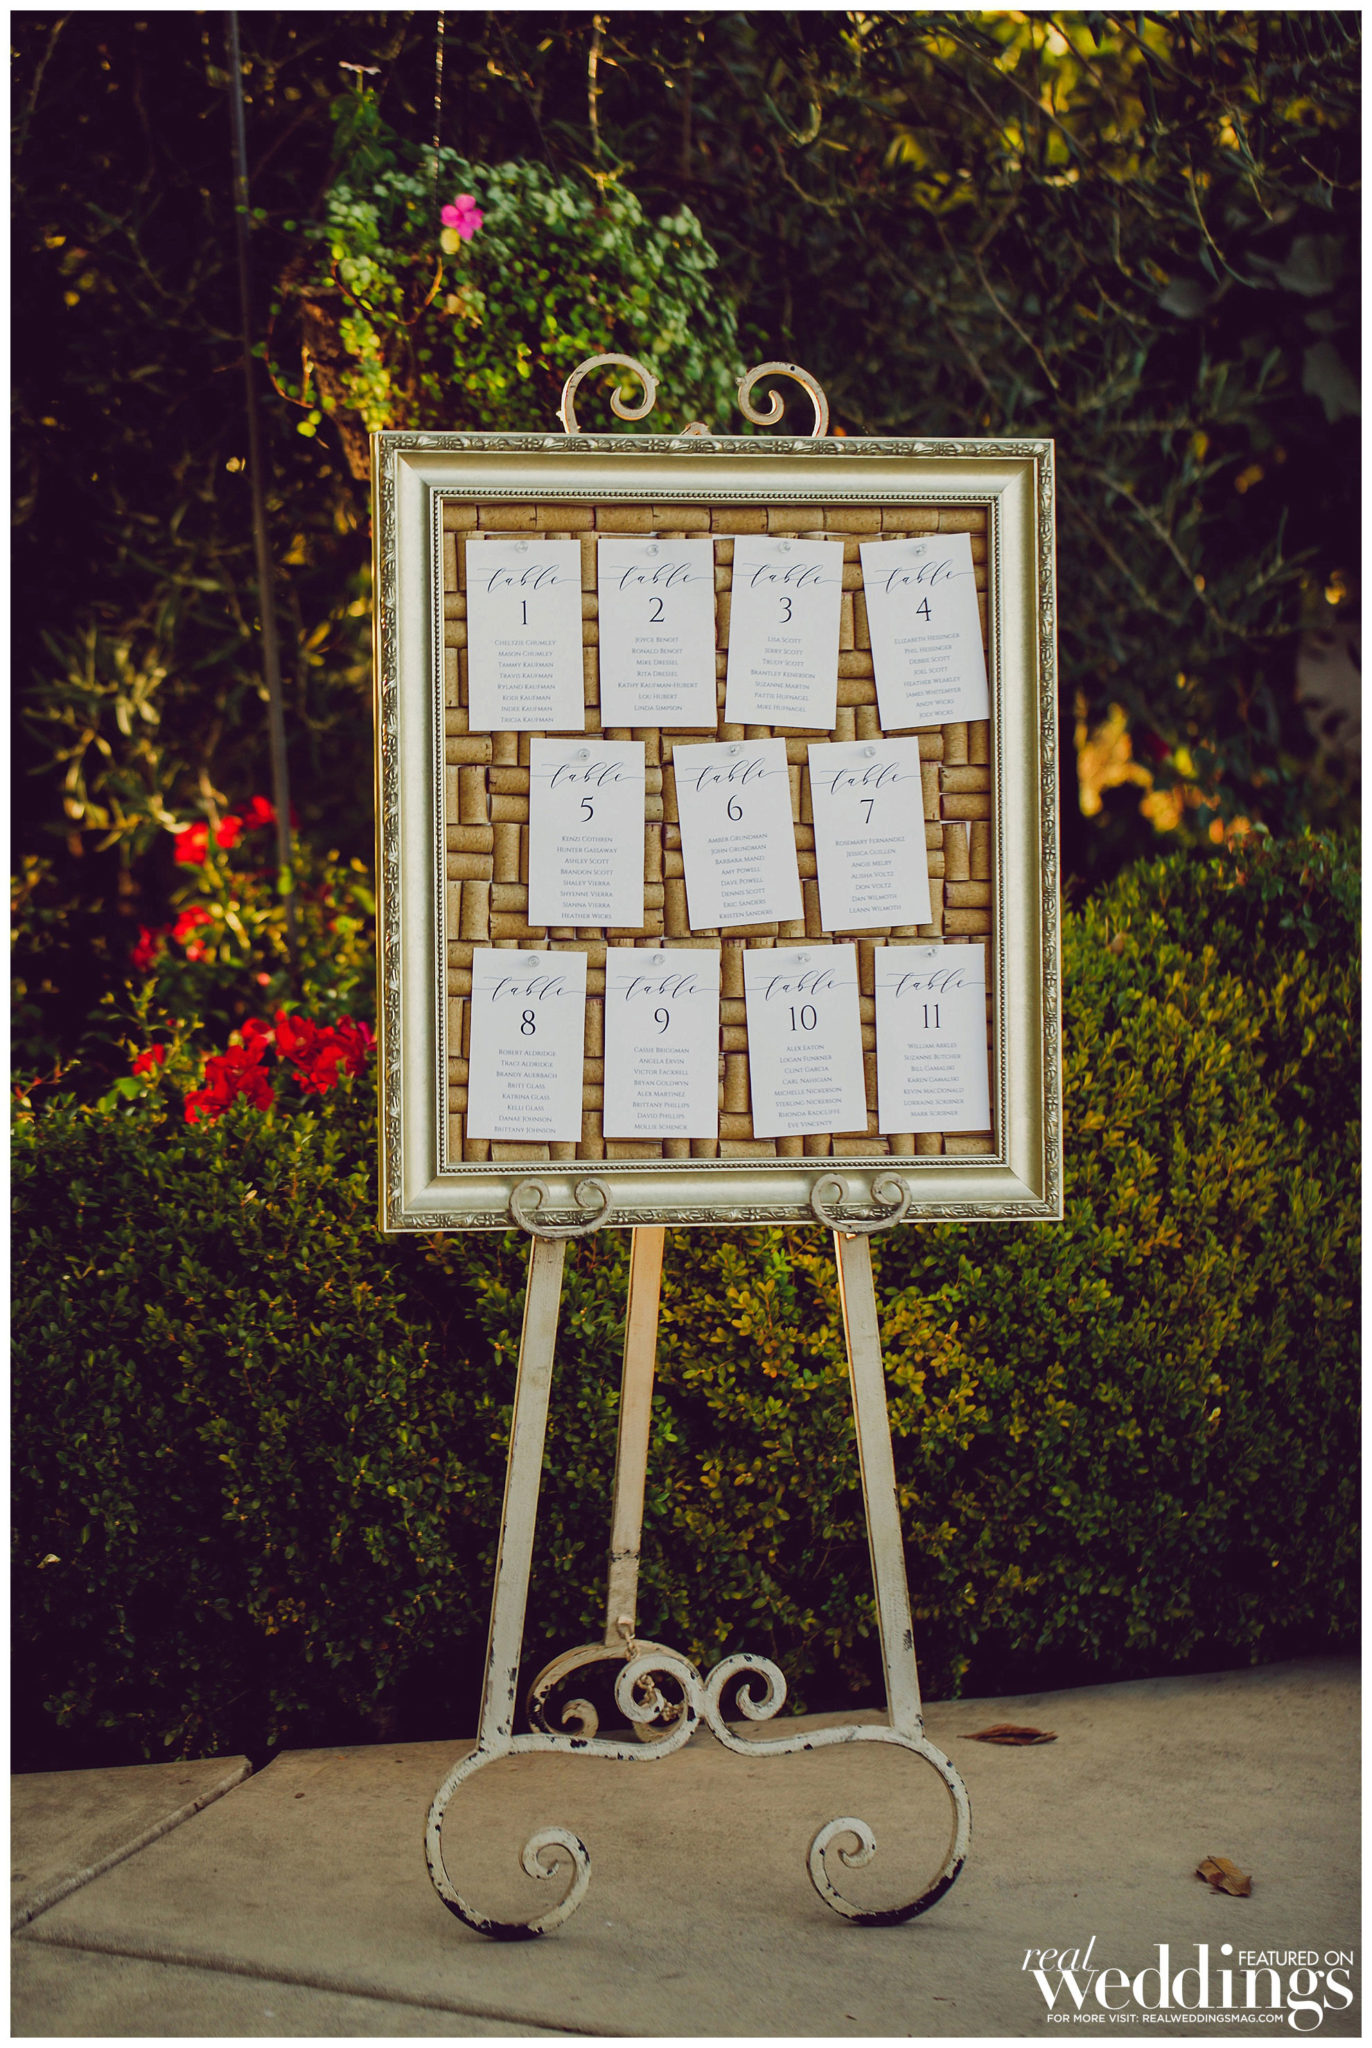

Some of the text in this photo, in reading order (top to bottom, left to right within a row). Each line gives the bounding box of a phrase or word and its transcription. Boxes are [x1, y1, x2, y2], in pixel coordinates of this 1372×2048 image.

[467, 564, 581, 594] table
[598, 562, 714, 591] table
[733, 562, 842, 588] table
[864, 559, 976, 594] table
[521, 600, 528, 625] 1
[648, 597, 665, 623] 2
[778, 596, 792, 624] 3
[916, 597, 932, 622] 4
[530, 761, 645, 789] table
[675, 757, 788, 792] table
[811, 762, 921, 795] table
[580, 796, 594, 822] 5
[727, 794, 743, 821] 6
[860, 798, 874, 824] 7
[472, 975, 586, 1002] table
[606, 973, 720, 1001] table
[745, 968, 858, 1001] table
[875, 968, 986, 998] table
[520, 1009, 536, 1036] 8
[654, 1008, 670, 1034] 9
[789, 1004, 817, 1031] 10
[922, 1003, 941, 1029] 11
